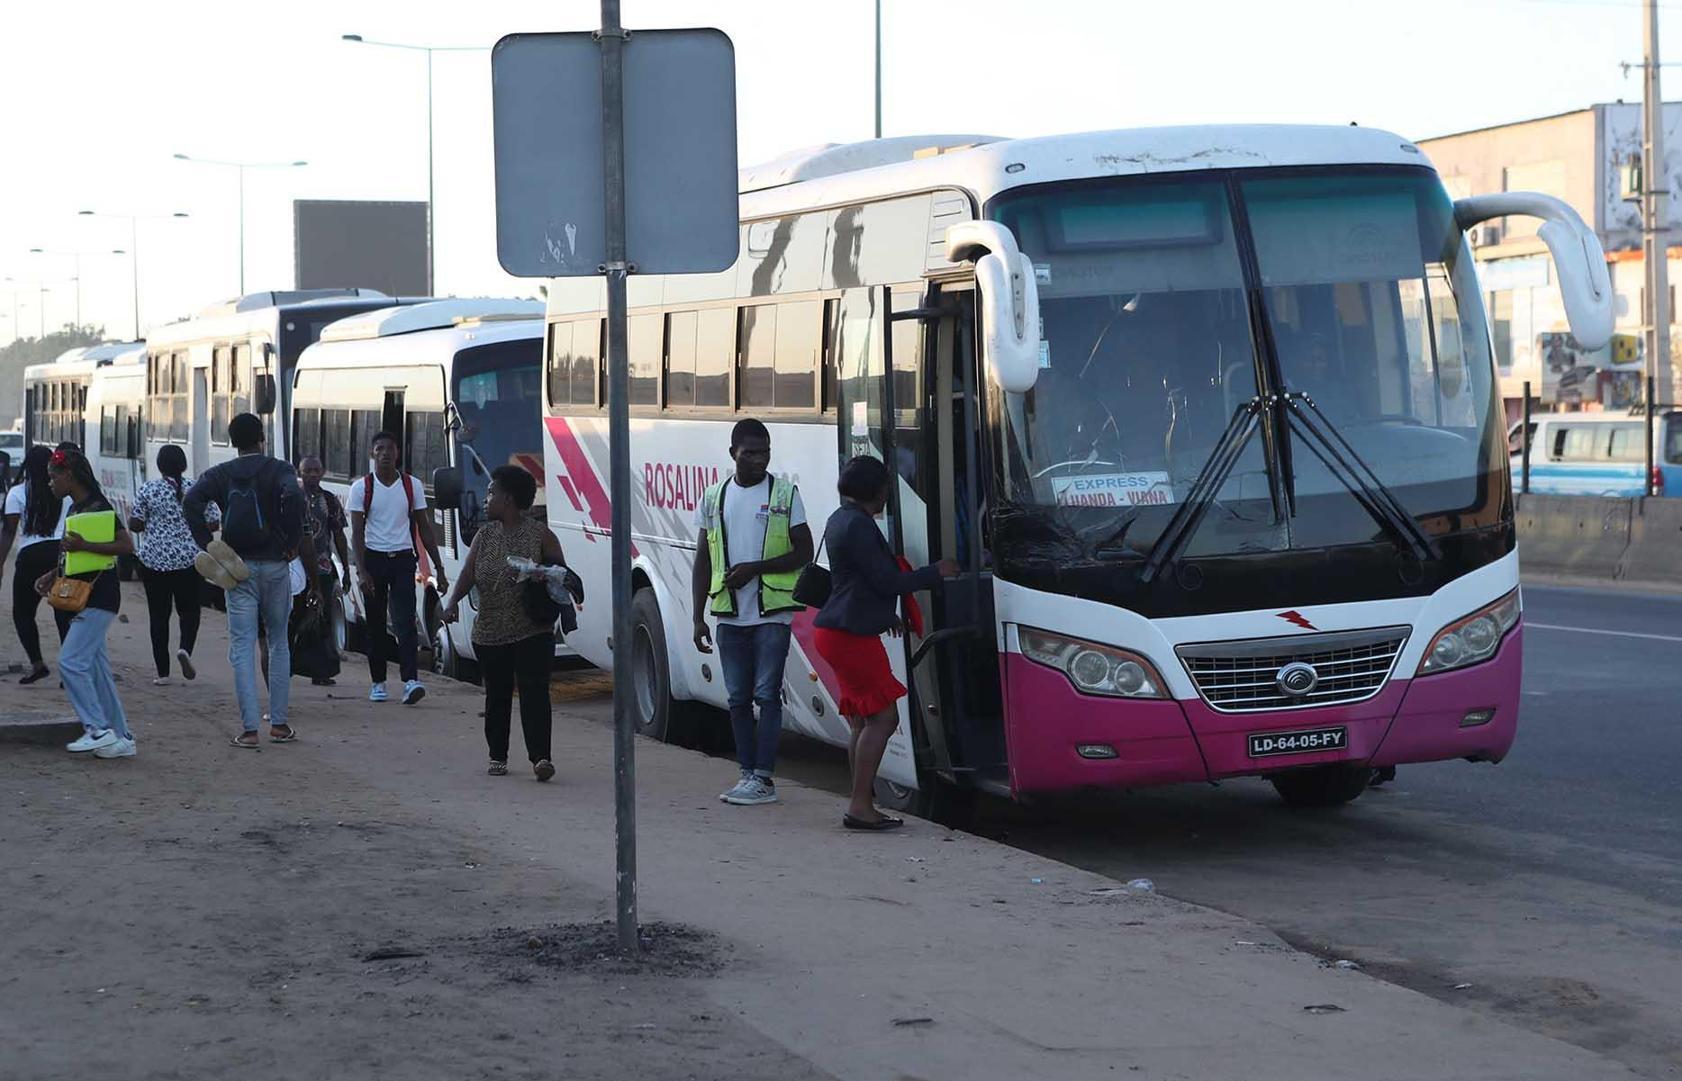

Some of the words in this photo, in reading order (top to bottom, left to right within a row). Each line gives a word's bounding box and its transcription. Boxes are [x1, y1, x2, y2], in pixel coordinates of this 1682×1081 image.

[1074, 476, 1149, 491] EXPRESS
[1127, 489, 1168, 505] VIANA
[1254, 732, 1342, 752] LD-64-05-FY
